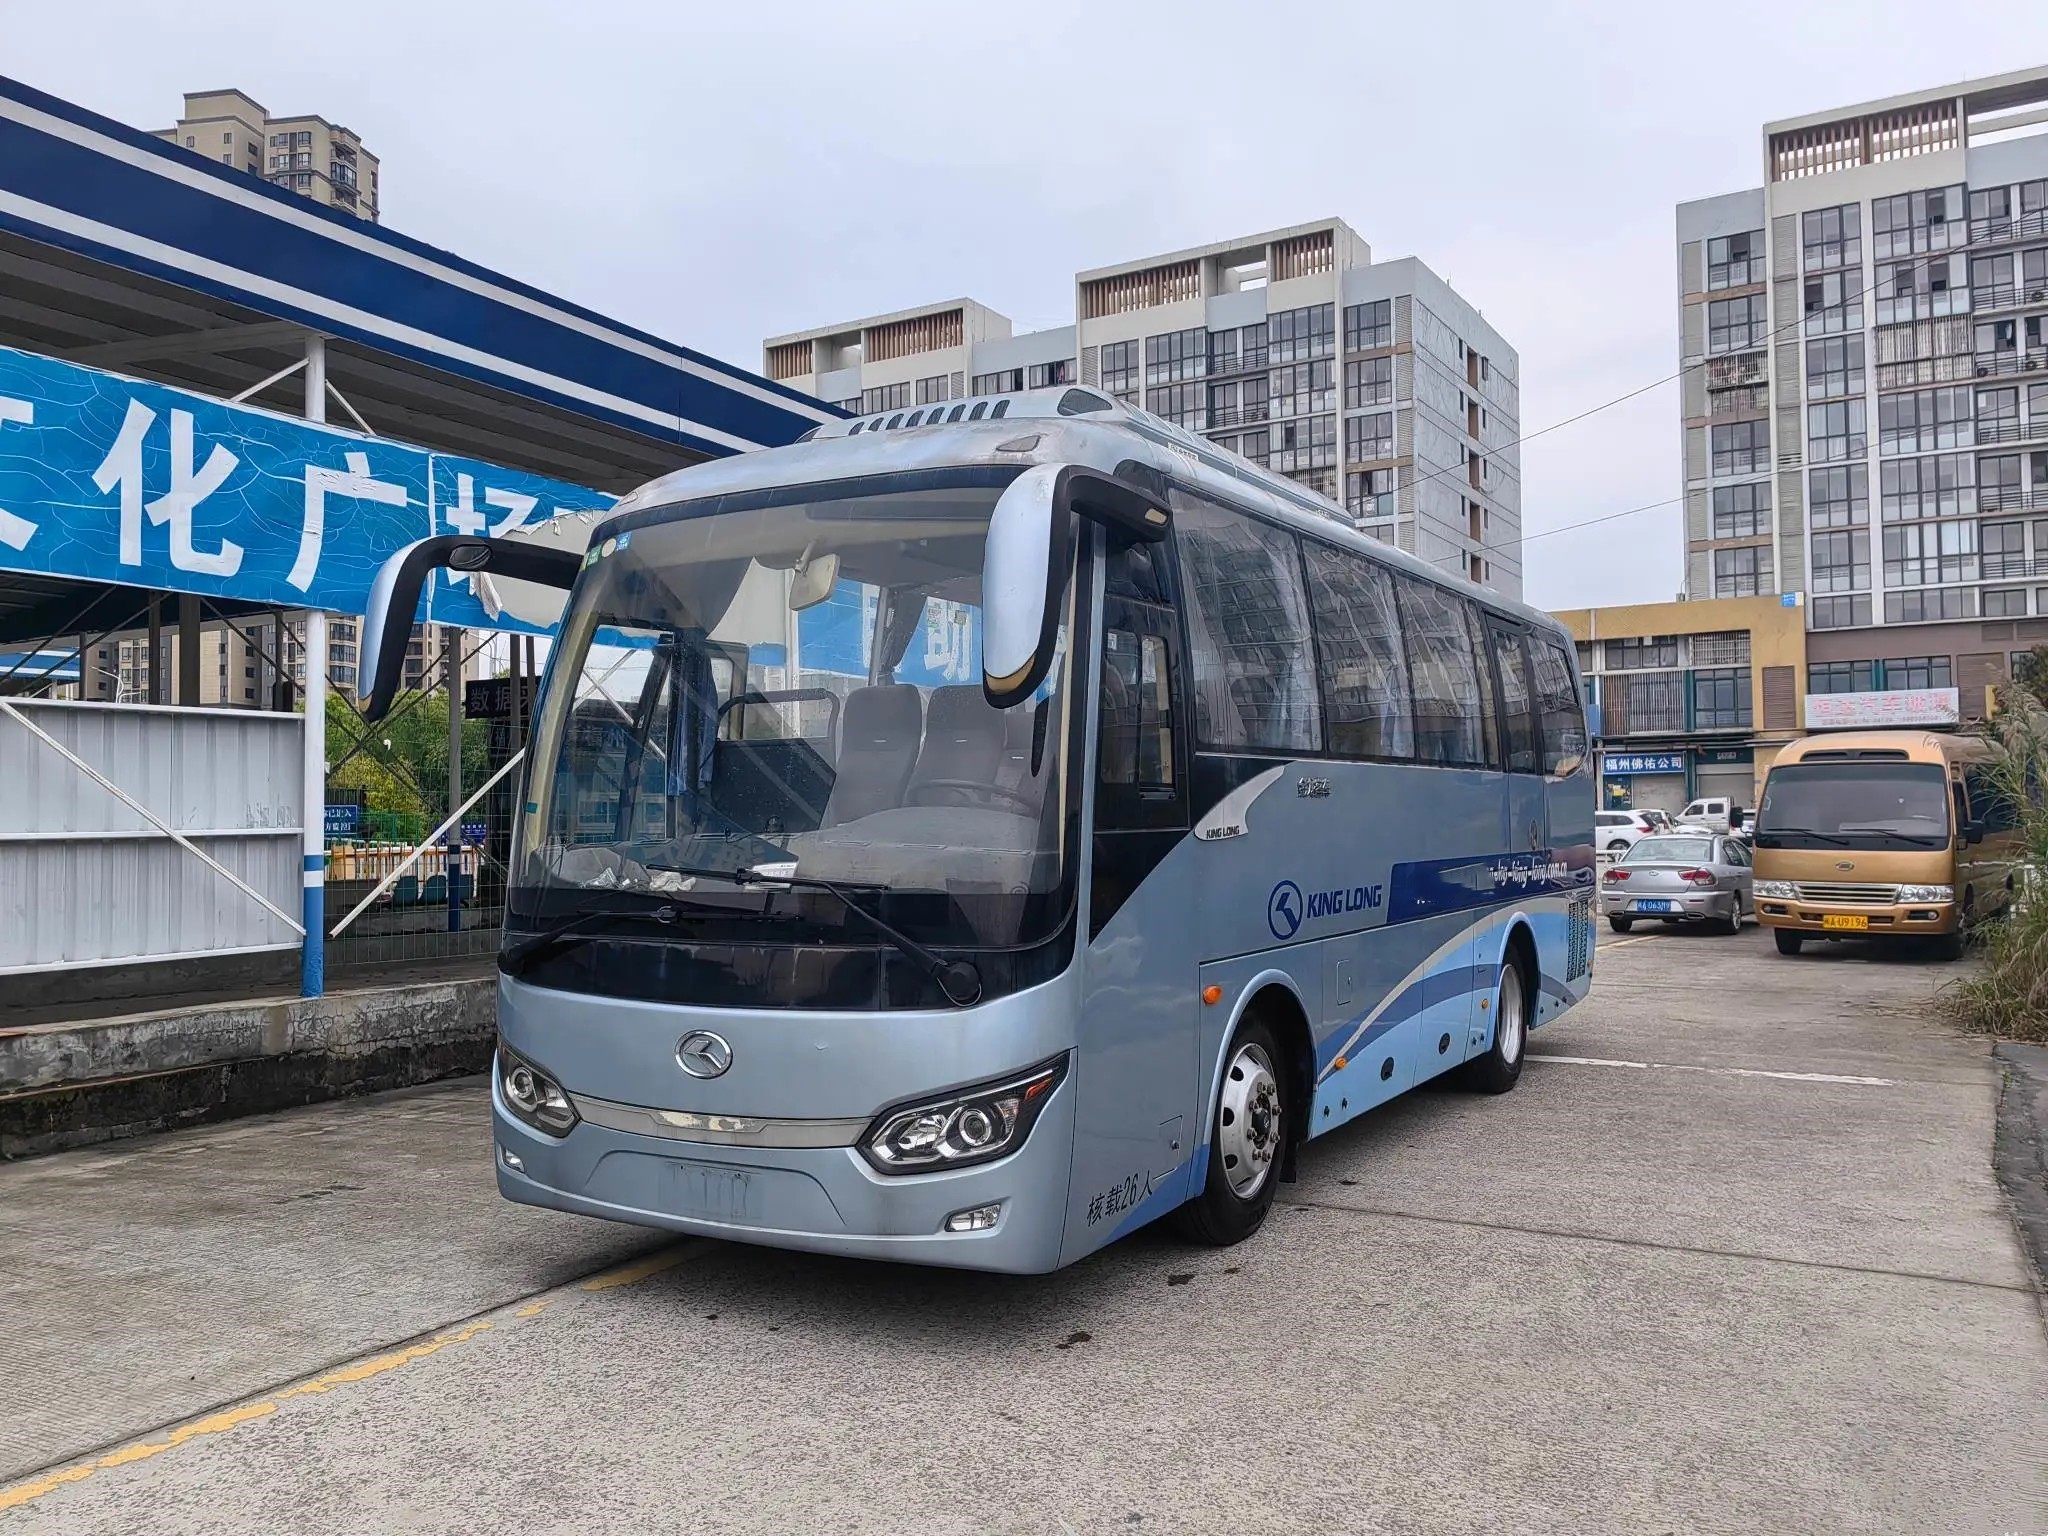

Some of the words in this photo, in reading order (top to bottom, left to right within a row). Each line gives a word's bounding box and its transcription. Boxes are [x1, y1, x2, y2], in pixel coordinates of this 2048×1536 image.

[0, 396, 552, 602] 化广
[1605, 757, 1682, 771] 福州佛佑公司
[1206, 829, 1222, 839] KING
[1223, 825, 1240, 837] LONG
[1307, 890, 1343, 918] KING
[1346, 885, 1382, 911] LONG
[1087, 1169, 1153, 1227] 核载26人
